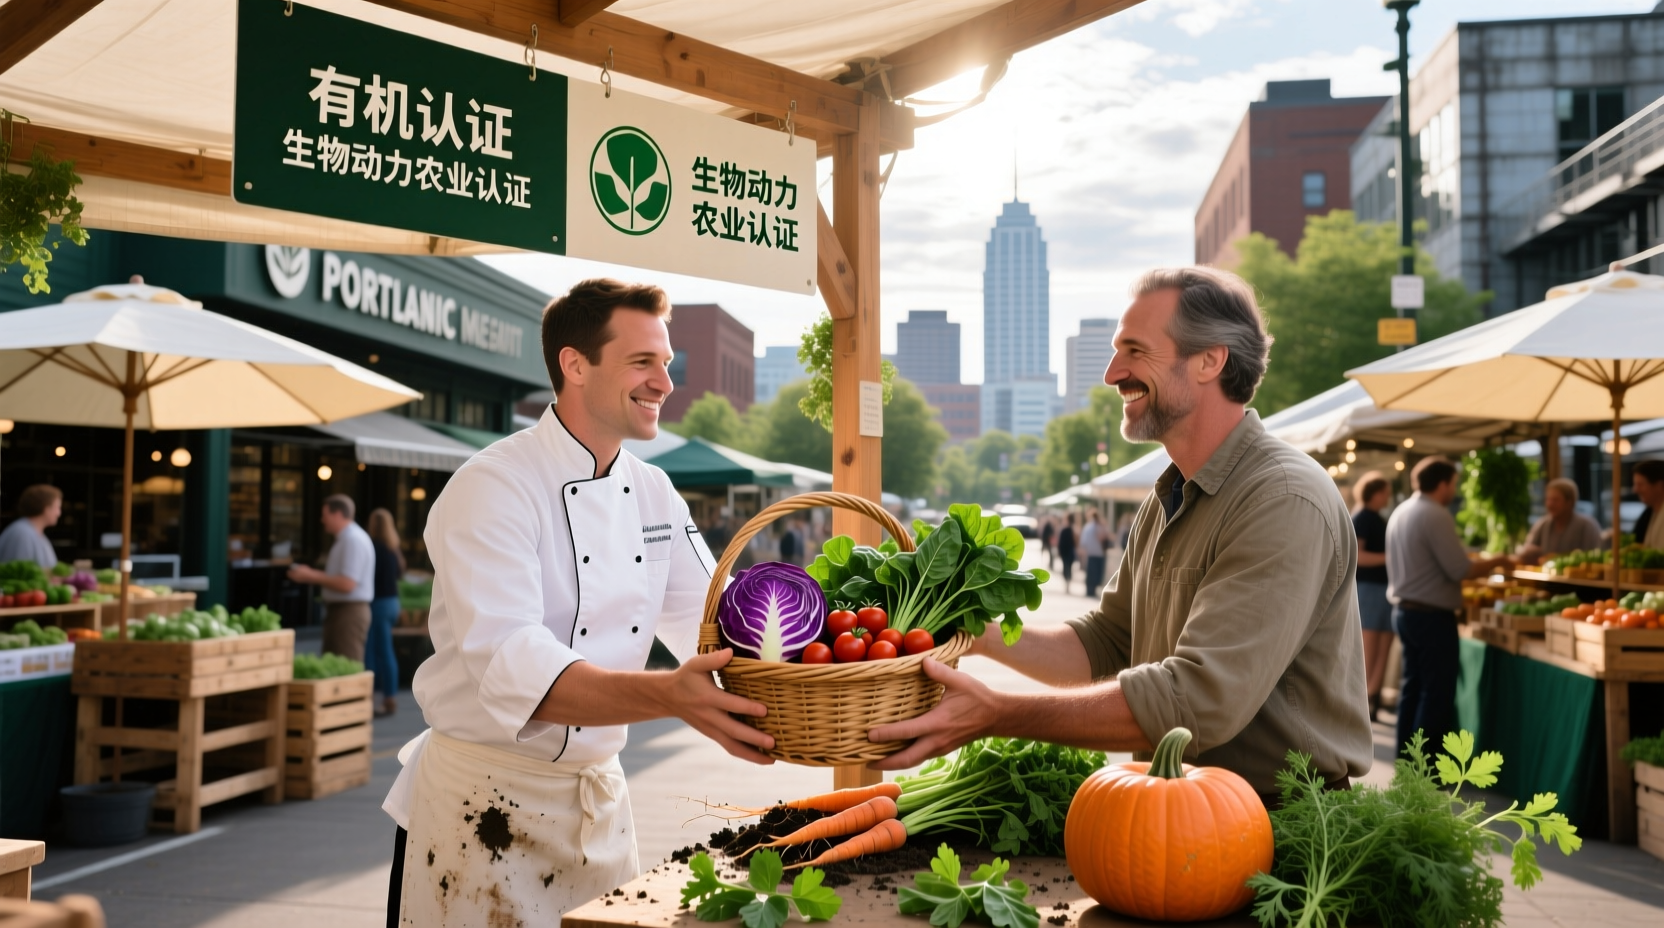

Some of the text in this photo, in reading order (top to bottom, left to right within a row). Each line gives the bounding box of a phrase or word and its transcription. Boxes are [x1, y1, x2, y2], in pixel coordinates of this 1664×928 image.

[308, 65, 513, 160] 有机认证
[282, 128, 532, 209] 生物动力农业认证
[691, 155, 798, 211] 生物动力
[691, 200, 799, 253] 农业认证
[322, 251, 456, 340] PORTLANIC
